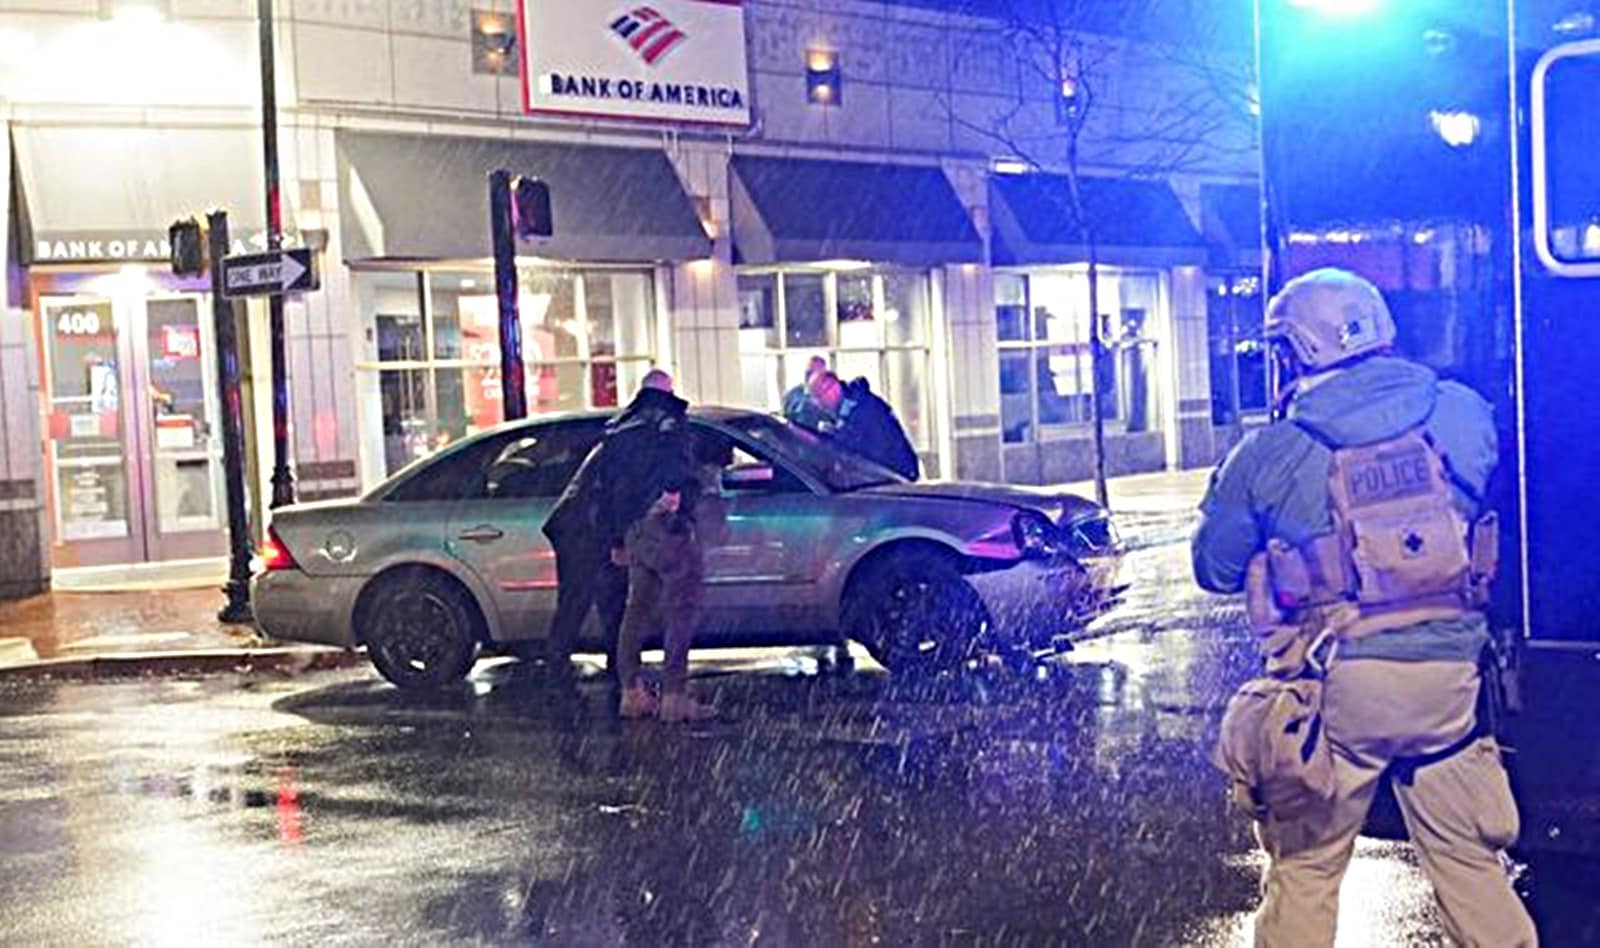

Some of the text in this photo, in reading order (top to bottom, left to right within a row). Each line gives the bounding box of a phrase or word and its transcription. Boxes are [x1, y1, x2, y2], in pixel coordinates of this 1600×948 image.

[551, 74, 743, 109] BANK OF AMERICA
[37, 240, 103, 259] BANK
[108, 239, 138, 259] OF
[258, 266, 282, 281] WAY
[58, 312, 100, 335] 400
[1351, 458, 1428, 495] POLICE
